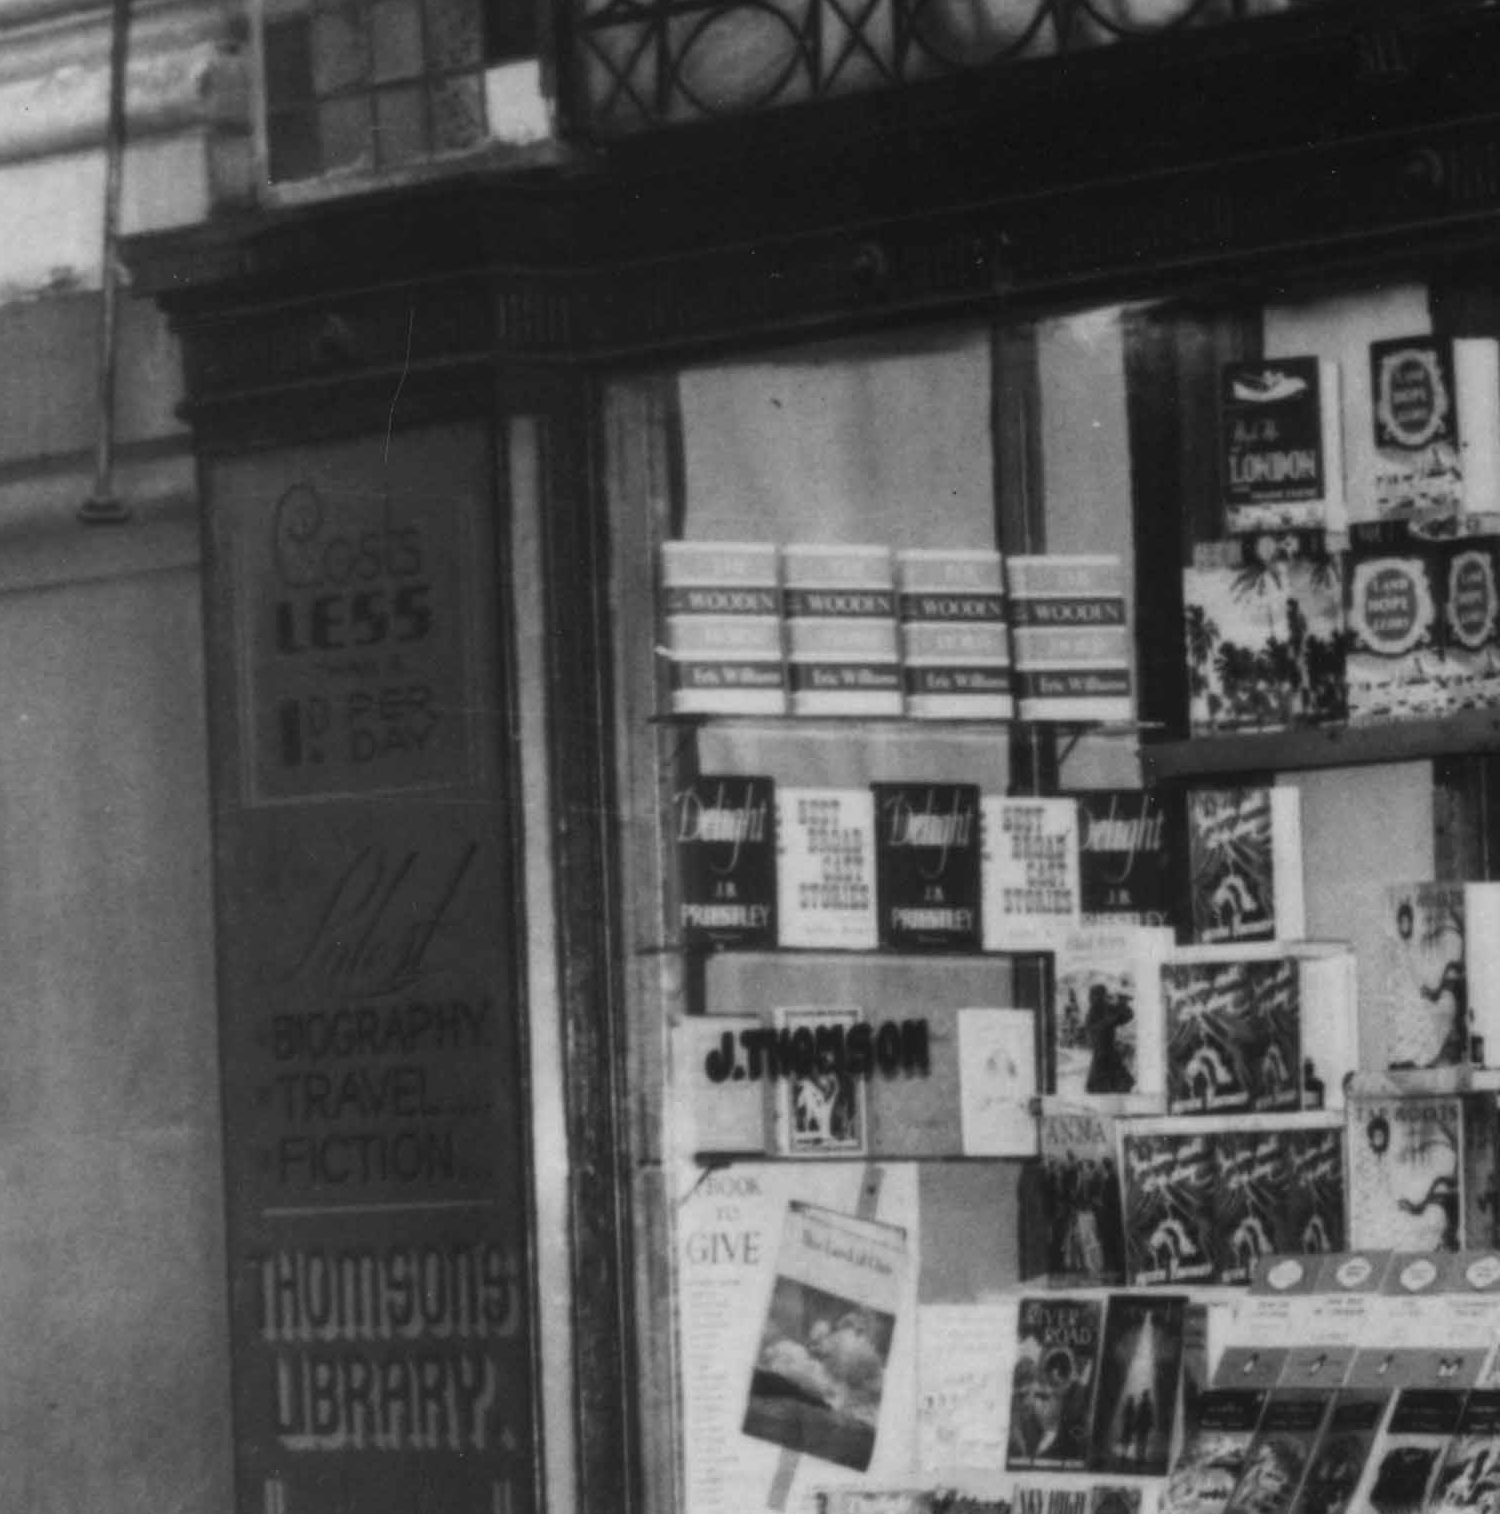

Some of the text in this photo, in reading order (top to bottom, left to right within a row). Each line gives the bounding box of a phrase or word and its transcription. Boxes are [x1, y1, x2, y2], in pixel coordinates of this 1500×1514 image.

[1229, 450, 1317, 483] LONDON
[688, 591, 775, 611] WOODEN
[807, 593, 891, 612] WOODEN
[921, 599, 1002, 618] WOODEN
[1034, 603, 1120, 623] WOODEN
[276, 585, 432, 655] LESS
[347, 685, 435, 728] PER
[351, 710, 440, 765] DAY
[673, 783, 768, 876] Delight
[884, 788, 973, 881] Delight
[680, 904, 771, 929] PRIESTLEY
[891, 908, 973, 931] PRIESTLEY
[1047, 1119, 1106, 1145] ANNA
[706, 1177, 763, 1197] BOOK
[715, 1206, 741, 1221] TO
[686, 1231, 761, 1266] GIVE
[1043, 1327, 1092, 1344] ROAD
